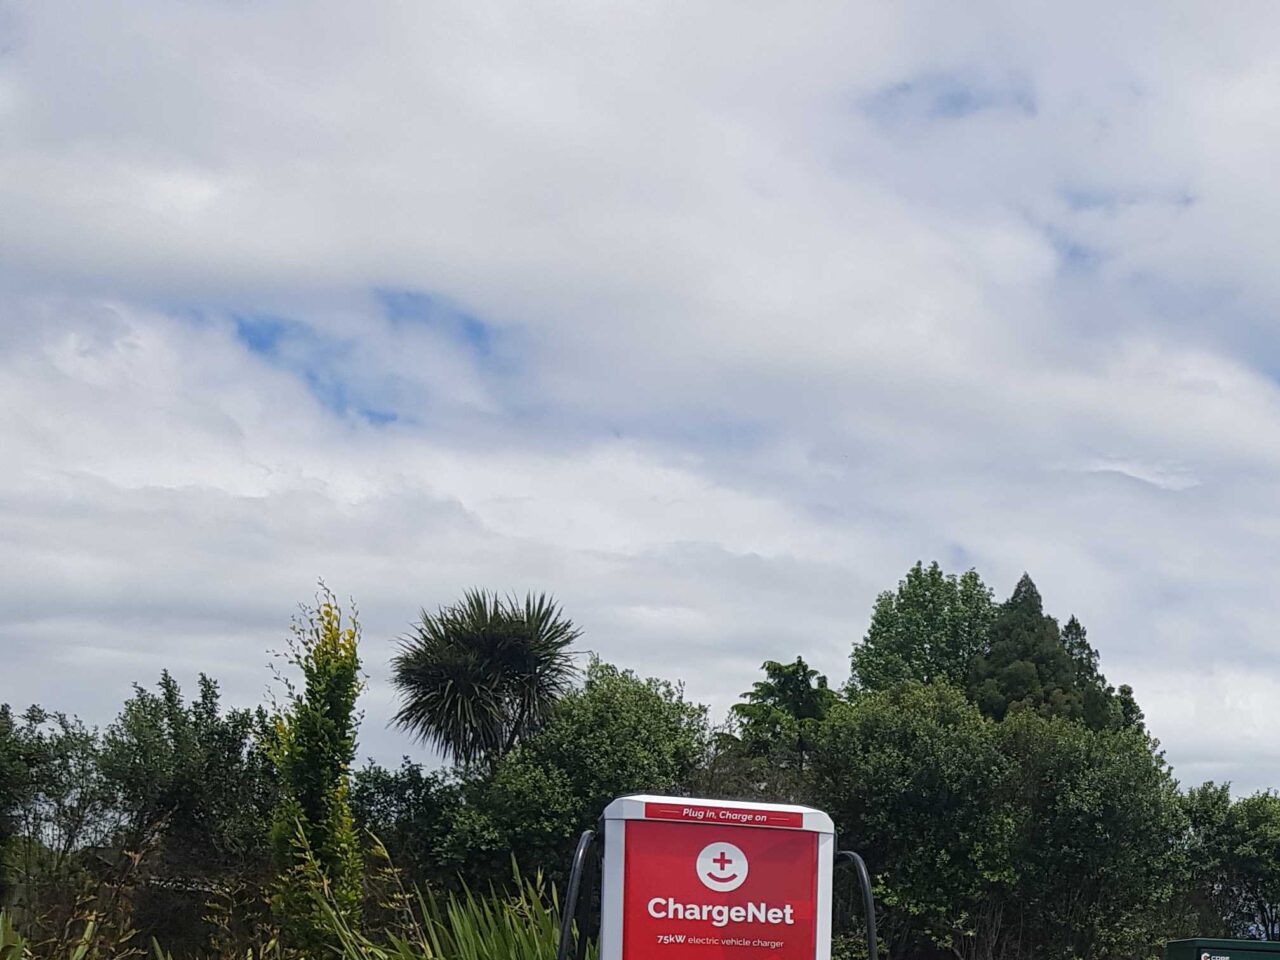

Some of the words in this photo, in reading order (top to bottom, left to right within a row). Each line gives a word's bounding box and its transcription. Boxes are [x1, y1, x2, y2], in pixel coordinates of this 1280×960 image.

[683, 808, 704, 820] Plug
[719, 811, 753, 823] Charge
[755, 814, 768, 822] on
[647, 897, 795, 927] ChargeNet
[657, 934, 686, 945] 75kW
[688, 936, 719, 945] electric
[721, 937, 751, 947] vehicle
[752, 938, 784, 949] charger
